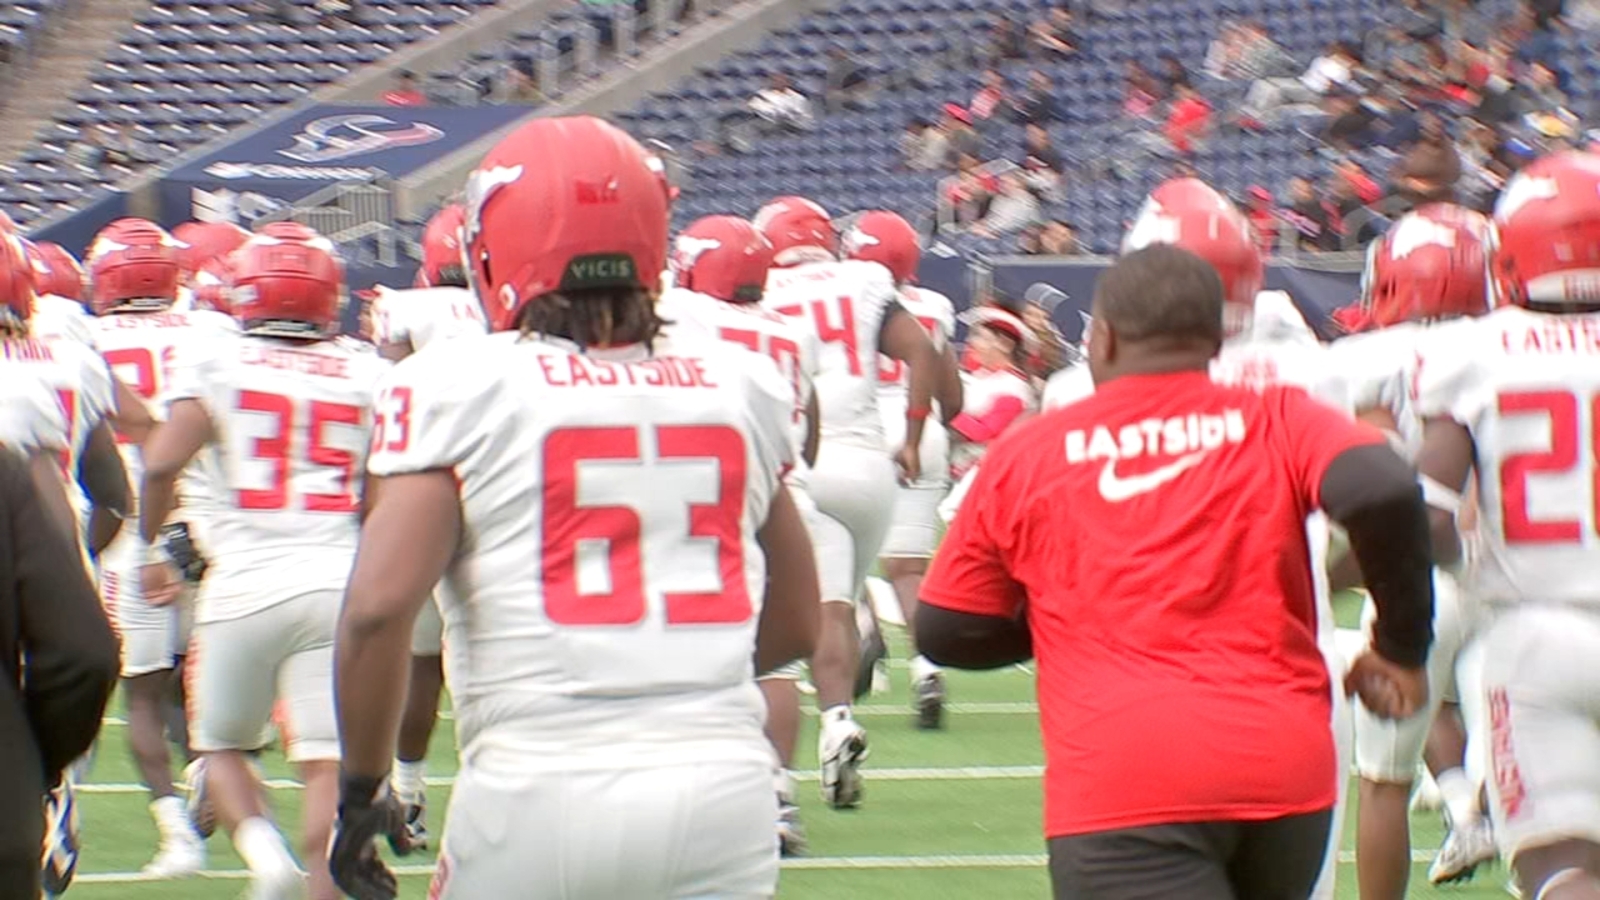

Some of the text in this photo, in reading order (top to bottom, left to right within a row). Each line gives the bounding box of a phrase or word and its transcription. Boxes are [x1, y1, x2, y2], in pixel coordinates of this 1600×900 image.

[570, 259, 631, 279] VICIS
[536, 353, 719, 388] EASTSIDE
[237, 389, 362, 513] 35
[1064, 407, 1247, 465] EASTSIDE
[541, 424, 753, 627] 63
